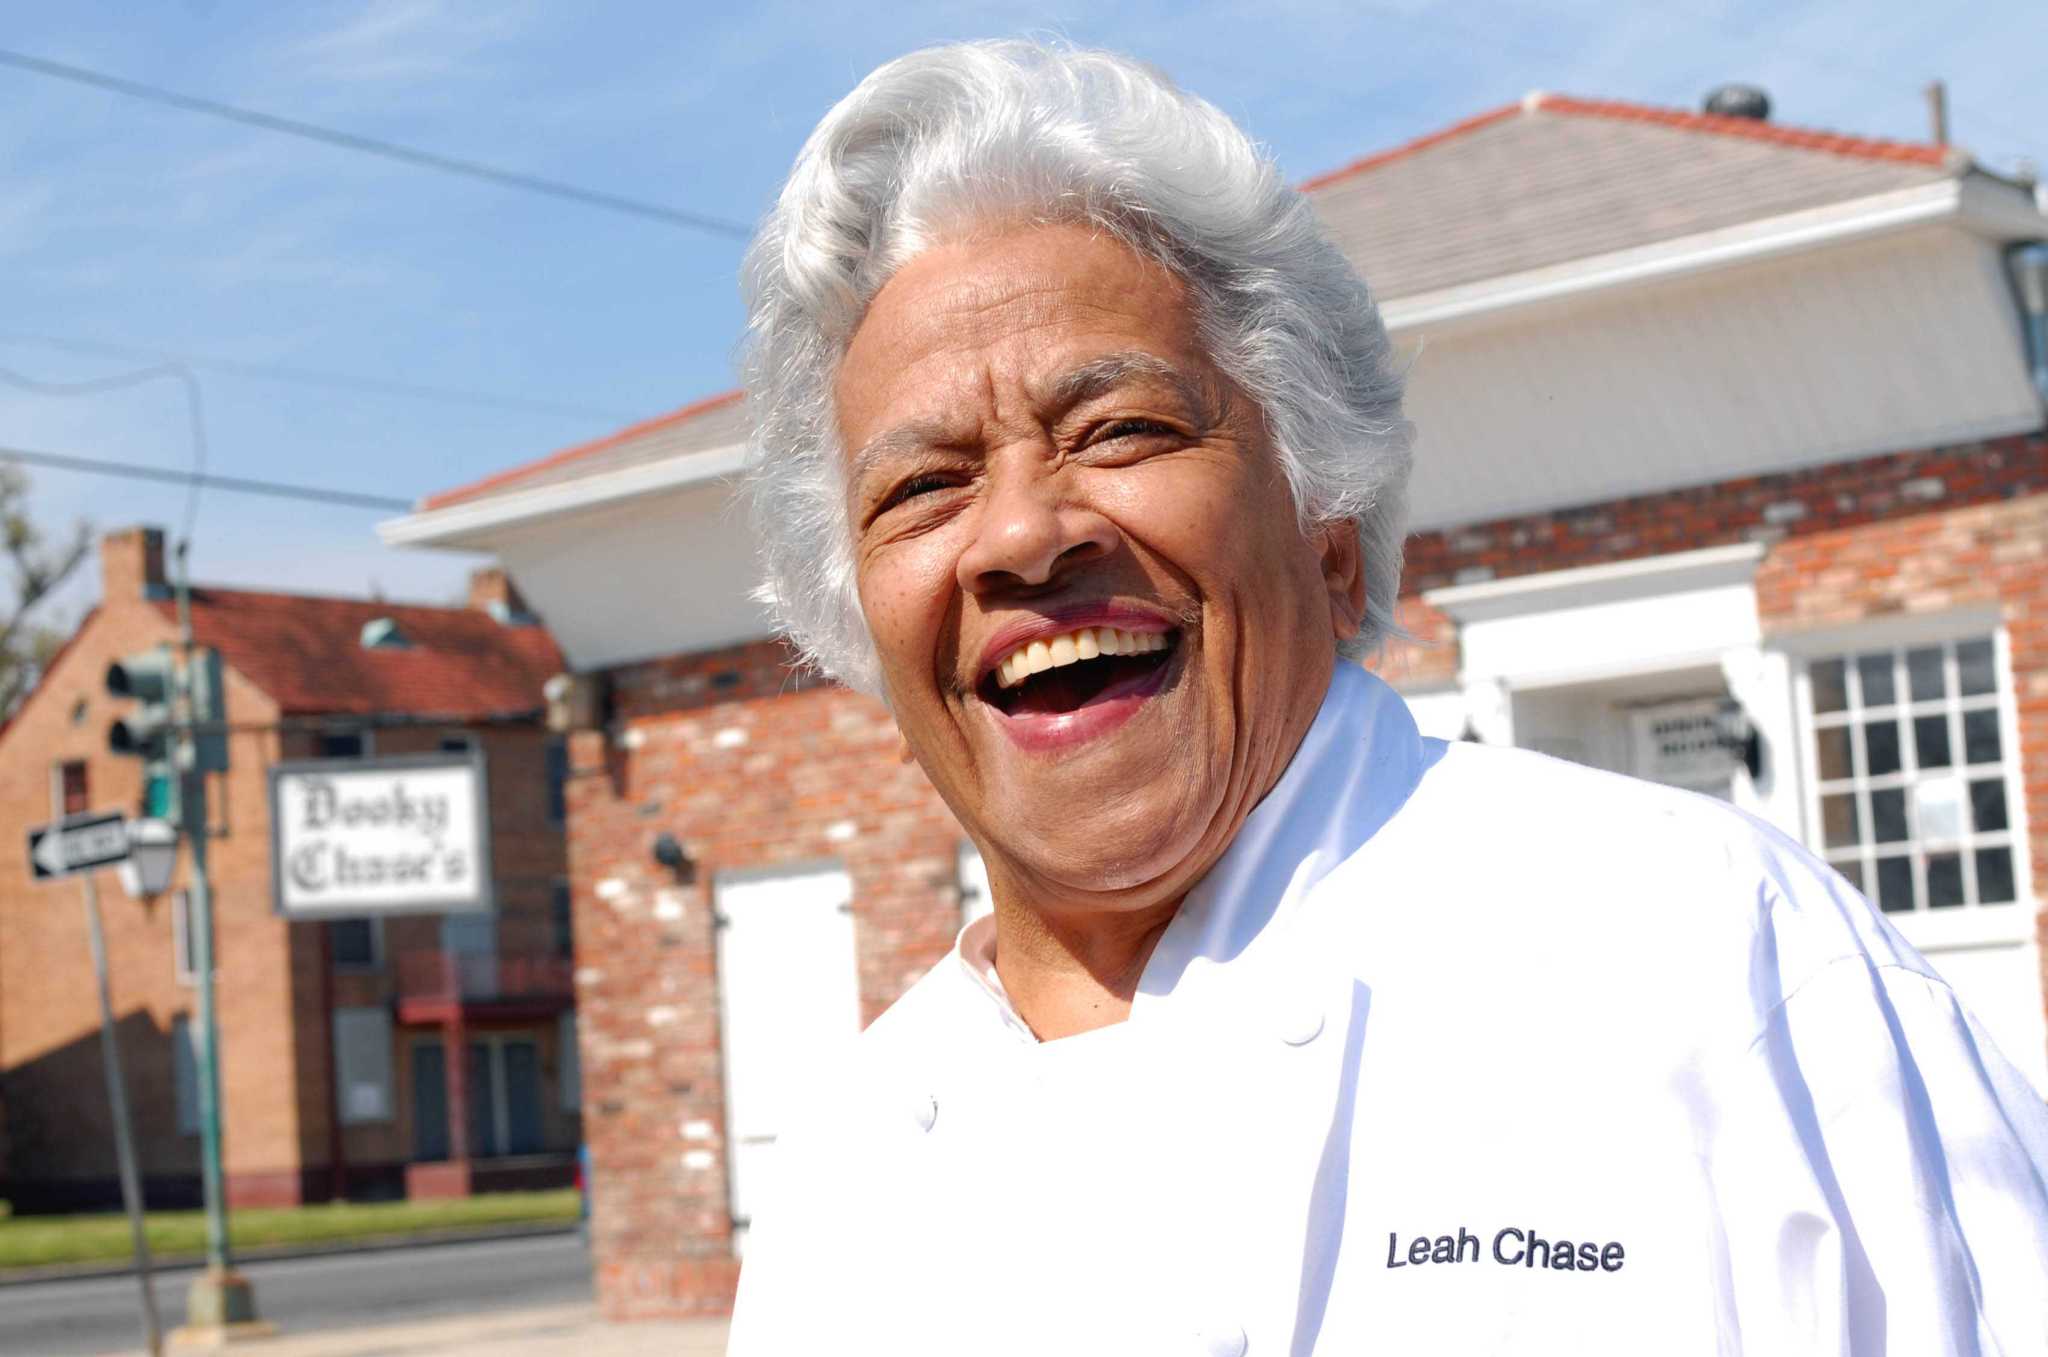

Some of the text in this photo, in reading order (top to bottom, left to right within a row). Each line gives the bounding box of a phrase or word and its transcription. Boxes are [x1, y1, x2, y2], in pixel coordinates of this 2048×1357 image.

[301, 774, 449, 834] Dooky
[287, 840, 467, 892] Chase's
[1387, 1227, 1625, 1272] Leah Chase
